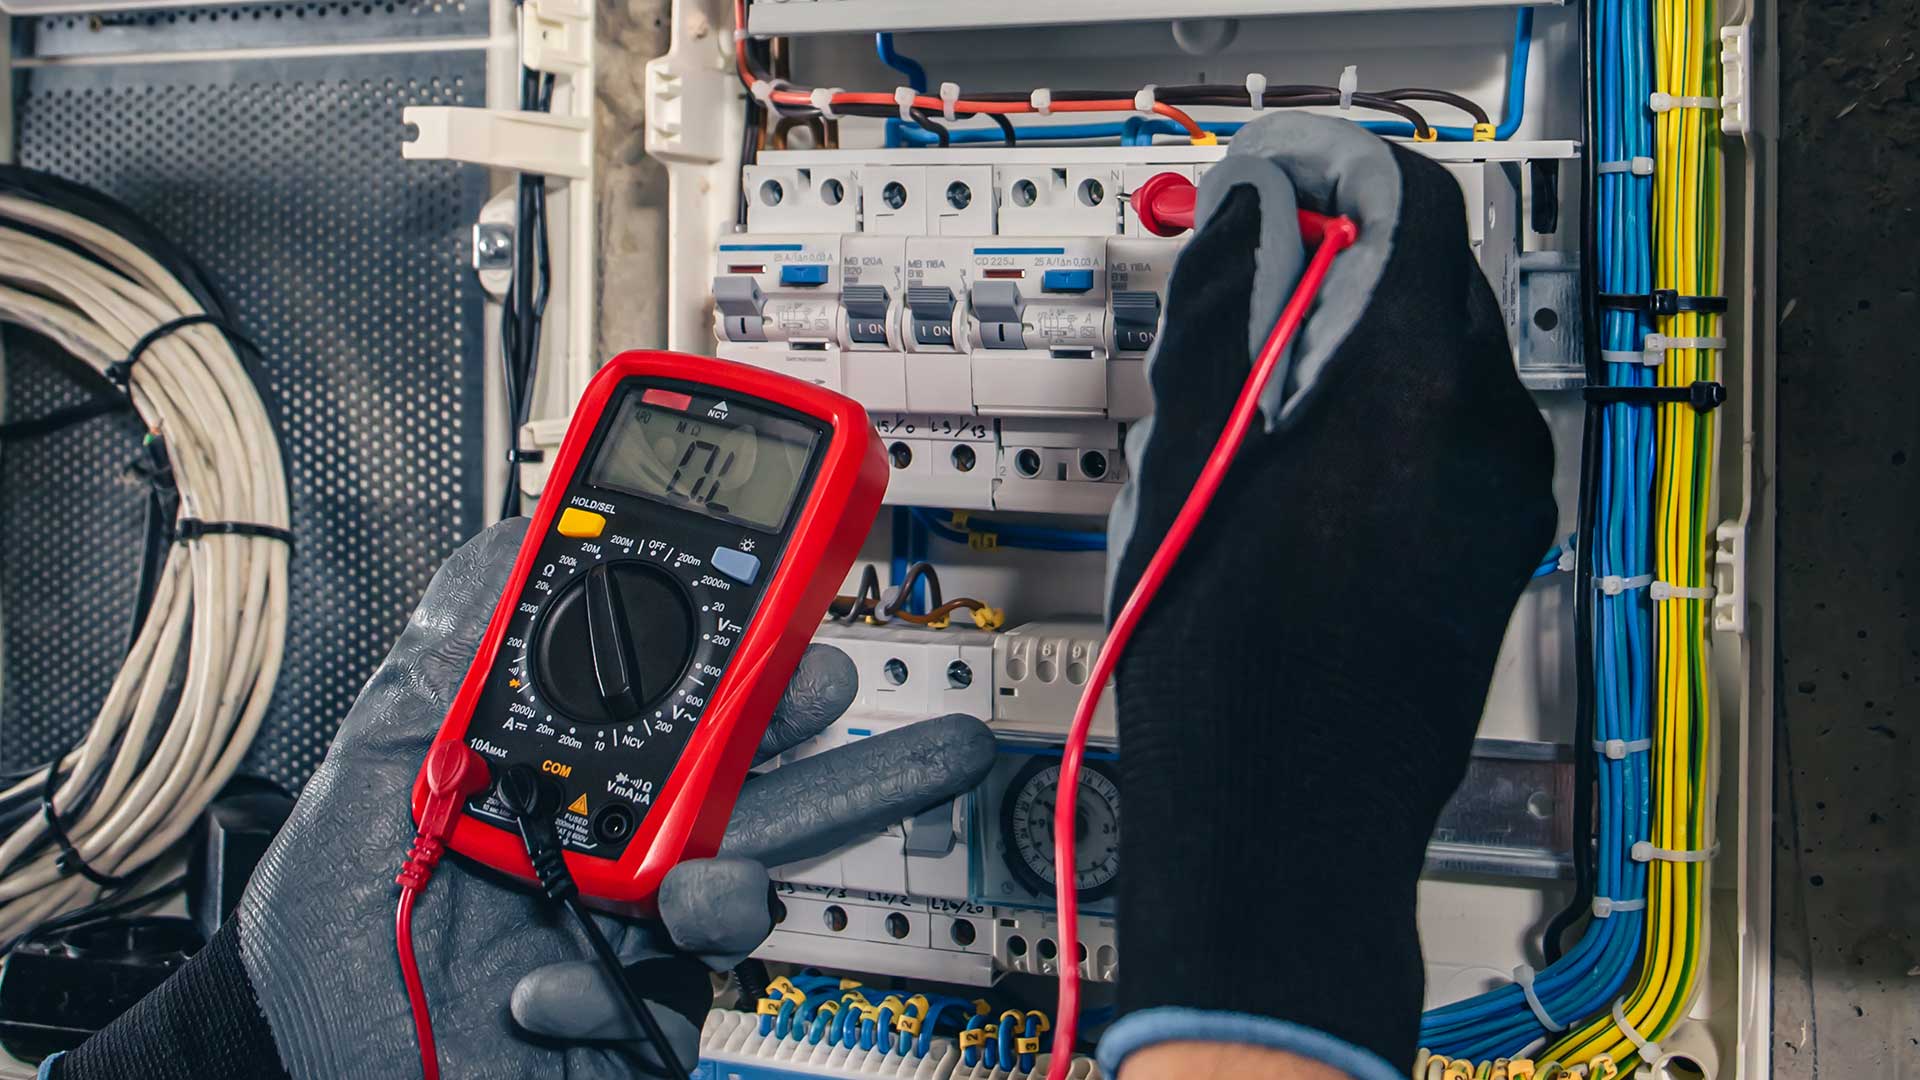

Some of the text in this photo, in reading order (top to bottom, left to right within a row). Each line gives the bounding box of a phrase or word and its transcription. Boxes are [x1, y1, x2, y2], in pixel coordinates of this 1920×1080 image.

[1111, 170, 1120, 180] N
[844, 257, 859, 266] MB
[908, 260, 923, 269] MB
[932, 325, 950, 336] ON
[707, 409, 729, 421] NCV
[571, 496, 616, 515] HOLD/SEL
[610, 535, 634, 548] 200M
[648, 540, 667, 551] OFF
[581, 542, 601, 554] 20M
[677, 553, 701, 567] 200m
[700, 575, 731, 591] 2000m
[520, 602, 539, 614] 2000
[712, 602, 725, 613] 20
[507, 637, 522, 648] 200
[712, 635, 731, 647] 200
[703, 664, 721, 678] 600
[685, 694, 704, 708] 600
[535, 723, 555, 736] 20m
[654, 720, 673, 733] 200
[558, 734, 583, 749] 200m
[594, 740, 605, 752] 10
[622, 734, 645, 749] NCV
[542, 760, 573, 778] COM
[564, 812, 589, 826] FUSED
[966, 1033, 978, 1042] 2
[1025, 1042, 1037, 1051] 3
